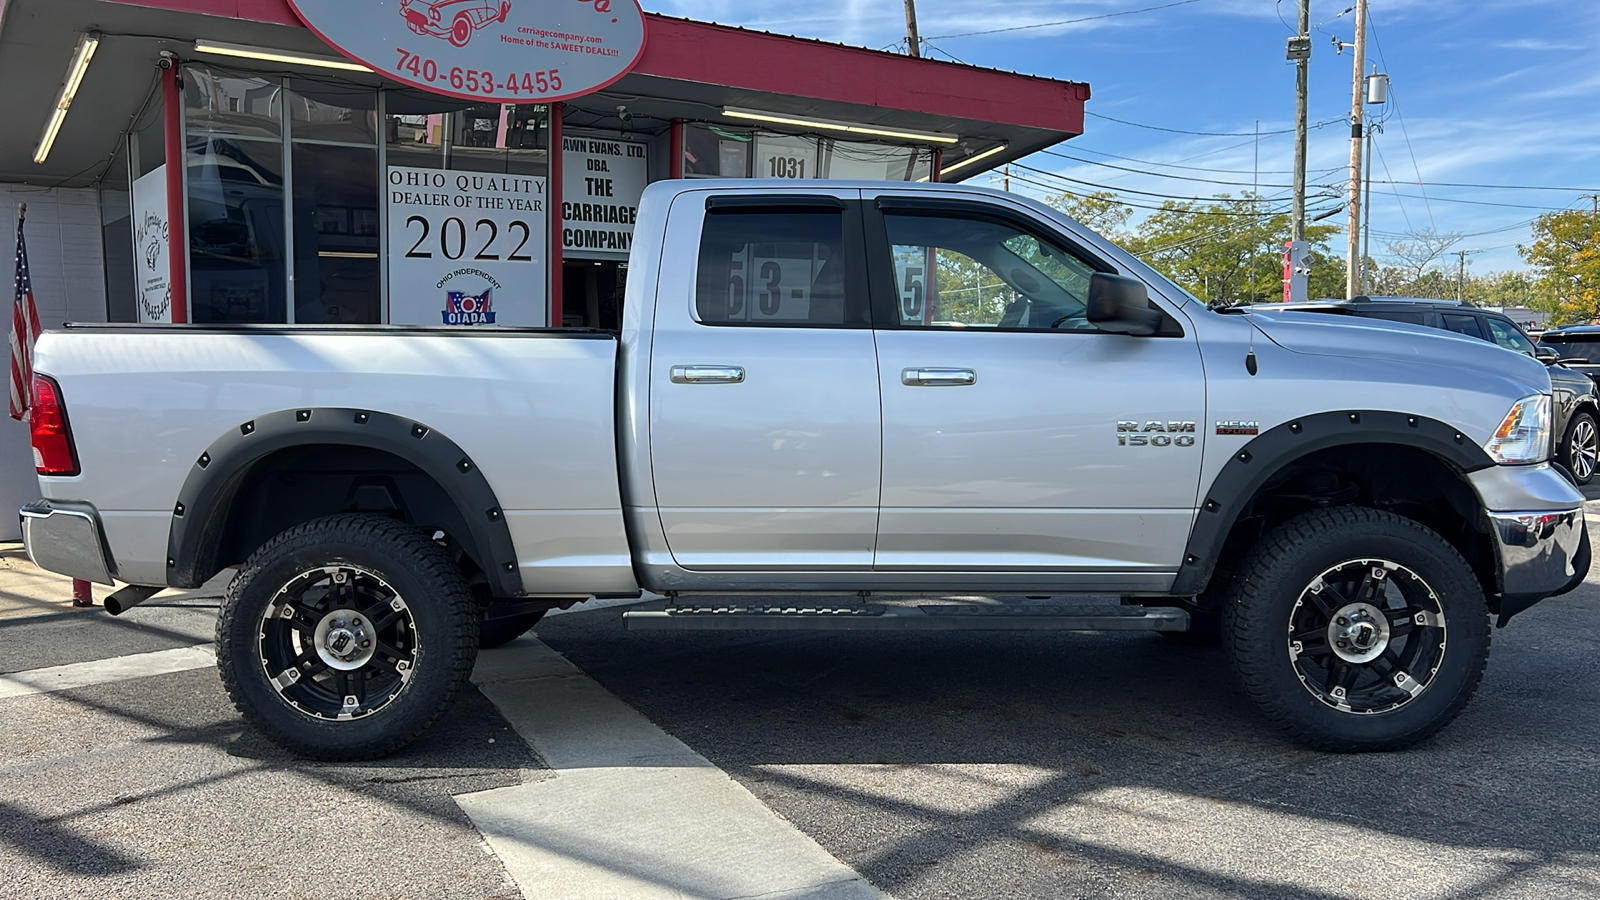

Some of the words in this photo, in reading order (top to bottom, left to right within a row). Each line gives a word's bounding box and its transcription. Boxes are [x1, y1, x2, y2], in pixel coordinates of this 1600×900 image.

[517, 26, 602, 43] carriagecompany.com
[500, 34, 524, 45] Home
[526, 38, 534, 46] of
[536, 40, 549, 48] the
[551, 41, 584, 53] SAWEET
[585, 46, 619, 57] DEALS!!!
[396, 47, 562, 94] 740-653-4455
[589, 141, 623, 156] EVANS.
[627, 144, 646, 159] LTD.
[586, 158, 610, 173] DBA.
[768, 156, 805, 179] 1031
[389, 170, 446, 188] OHIO
[456, 175, 545, 194] QUALITY
[585, 177, 613, 197] THE
[392, 191, 450, 206] DEALER
[453, 195, 473, 208] OF
[476, 196, 504, 209] THE
[507, 198, 543, 212] YEAR
[562, 201, 636, 225] CARRIAGE
[404, 215, 532, 262] 2022
[436, 272, 453, 289] OHIO
[453, 267, 502, 290] INDEPENDENT
[448, 312, 487, 323] OIADA
[1116, 420, 1196, 433] RAM
[1216, 420, 1260, 428] HEMI
[1116, 434, 1195, 447] 1500
